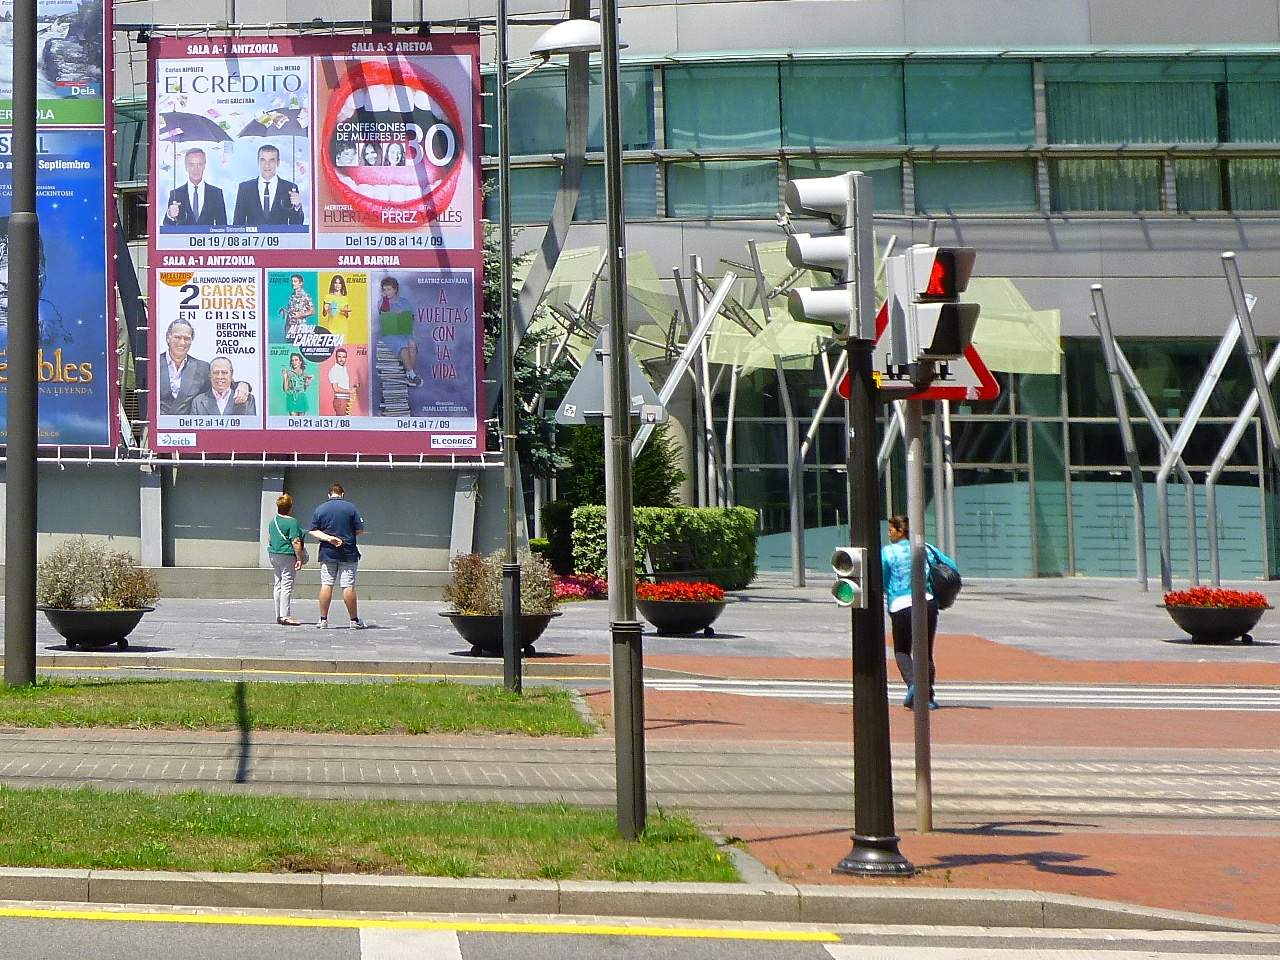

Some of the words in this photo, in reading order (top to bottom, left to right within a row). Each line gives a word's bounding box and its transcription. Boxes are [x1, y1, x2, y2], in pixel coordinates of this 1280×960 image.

[187, 44, 210, 55] SALA
[212, 44, 227, 54] A-1
[231, 43, 279, 54] ANTZOKIA
[352, 42, 375, 52] SALA
[376, 42, 394, 52] A-3
[395, 41, 433, 52] ARETOA
[165, 76, 188, 94] EL
[192, 72, 302, 94] CRÉDITO
[336, 122, 406, 132] CONFESIONES
[336, 132, 349, 141] DE
[351, 132, 391, 141] MUJERES
[393, 132, 406, 141] DE
[405, 123, 456, 167] 30
[38, 159, 91, 172] Septiembre
[381, 207, 418, 224] PÉREZ
[189, 236, 206, 247] Del
[208, 236, 220, 247] 19
[241, 236, 251, 247] al
[345, 236, 362, 246] Del
[364, 236, 377, 246] 15
[398, 236, 408, 246] al
[163, 255, 187, 266] SALA
[188, 255, 204, 266] A-1
[207, 255, 256, 266] ANTZOKIA
[338, 255, 362, 266] SALA
[363, 255, 401, 266] BARRIA
[179, 284, 200, 305] 2
[201, 284, 256, 297] CARAS
[439, 289, 447, 304] A
[201, 297, 256, 310] DURAS
[179, 311, 196, 320] EN
[206, 311, 256, 320] CRISIS
[418, 307, 469, 323] VUELTAS
[216, 330, 257, 338] OSBORNE
[432, 326, 455, 342] CON
[293, 333, 345, 347] CARRETERA
[437, 345, 451, 361] LA
[432, 364, 457, 380] VIDA
[179, 418, 193, 427] Del
[194, 418, 205, 427] 12
[205, 418, 213, 427] al
[288, 418, 302, 428] Del
[303, 419, 313, 428] 21
[314, 419, 323, 428] al
[397, 419, 411, 429] Del
[411, 420, 417, 428] 4
[419, 420, 427, 428] al
[172, 437, 191, 446] eitb
[441, 437, 473, 445] CORREO
